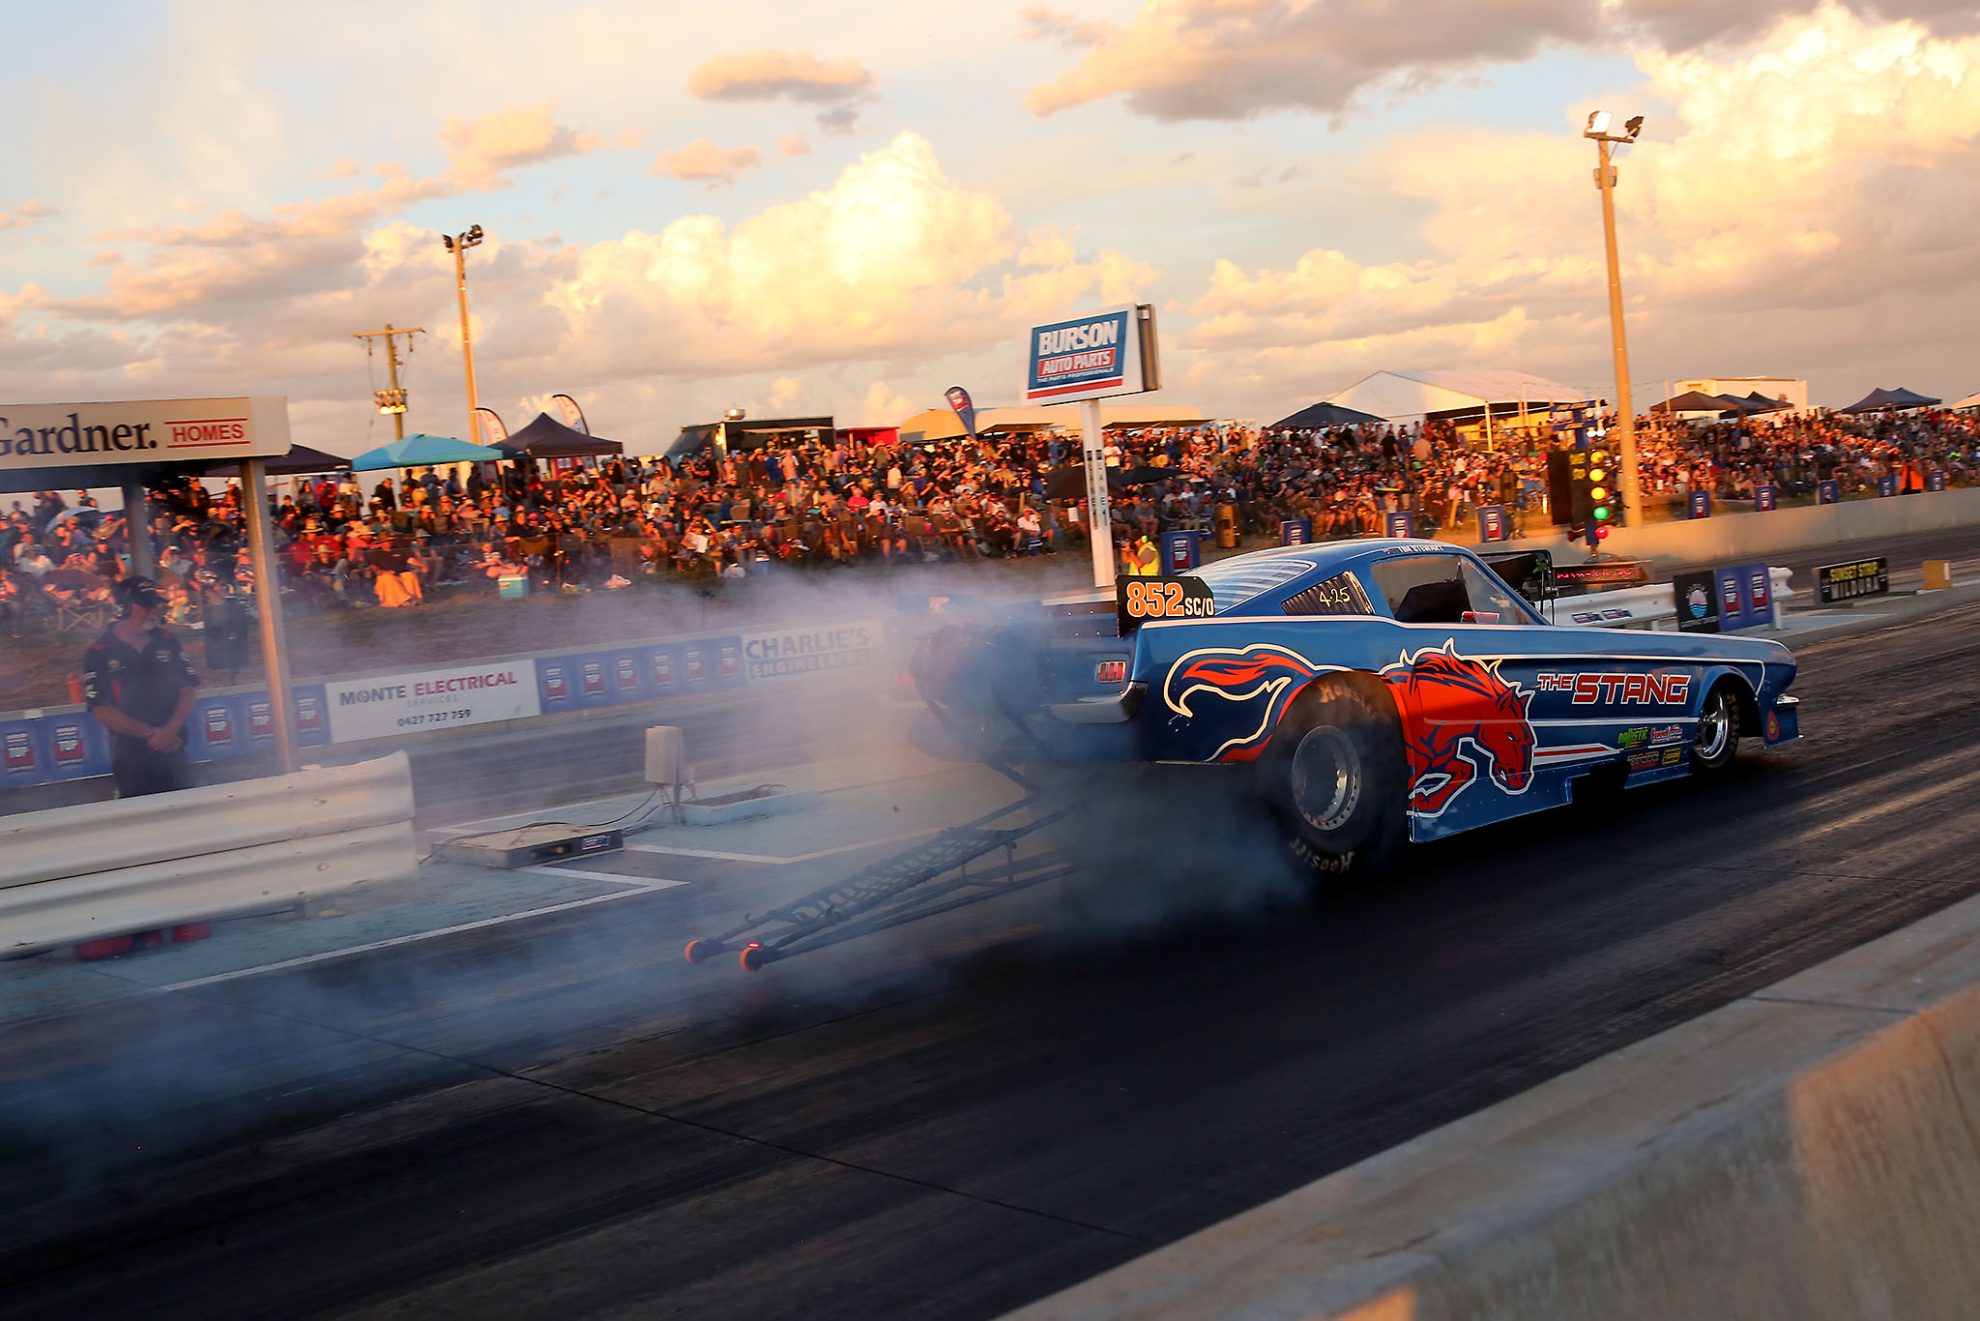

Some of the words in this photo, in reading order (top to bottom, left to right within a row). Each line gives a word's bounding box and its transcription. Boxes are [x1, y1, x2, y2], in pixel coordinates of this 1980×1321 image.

[1038, 319, 1119, 356] BURSON
[1042, 357, 1073, 375] AUTO
[1074, 351, 1111, 369] PARTS
[172, 423, 245, 443] HOMES
[1829, 565, 1857, 583] SUNSET
[1126, 581, 1185, 618] 852
[1184, 597, 1214, 617] SC/O
[1319, 586, 1351, 608] 4.25
[745, 626, 870, 660] CHARLIE'S
[339, 684, 407, 706] MONTE
[413, 671, 518, 697] ELECTRICAL
[1537, 673, 1577, 692] THE
[1572, 672, 1692, 705] STANG
[428, 712, 448, 724] 727
[451, 709, 472, 720] 759
